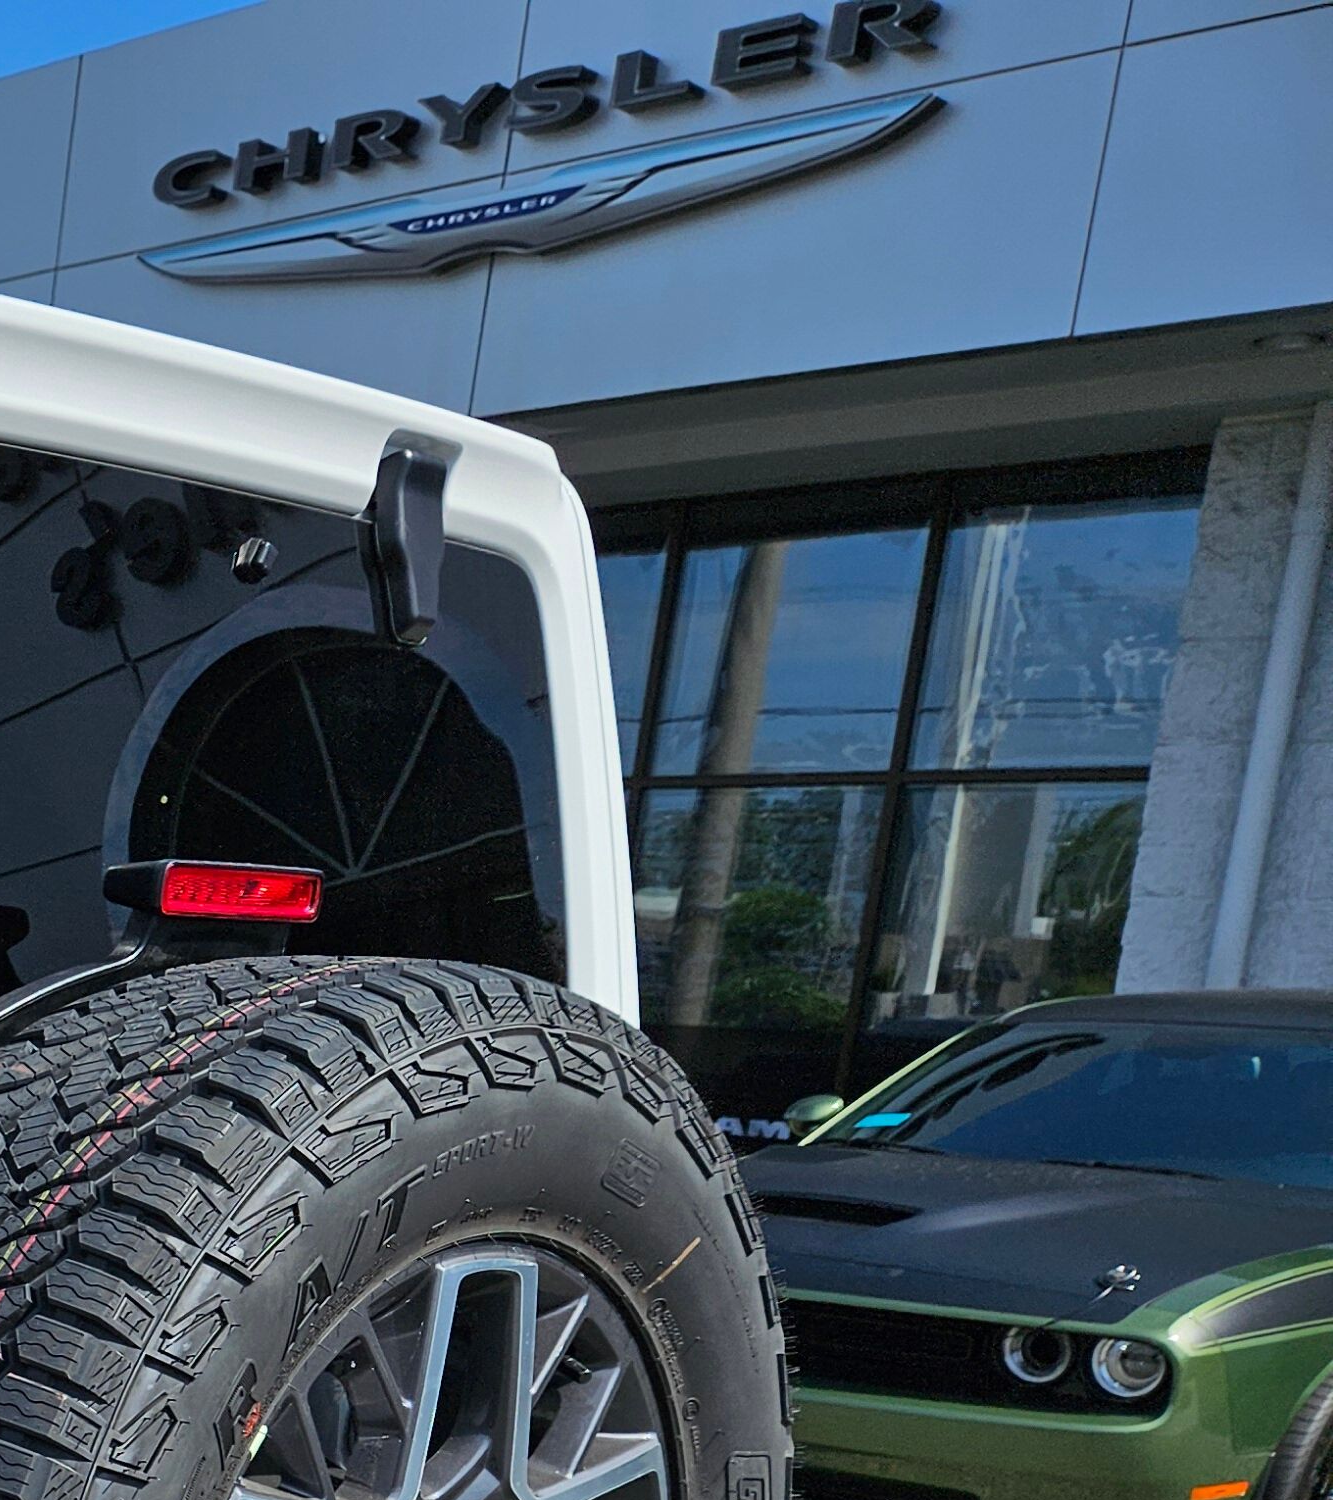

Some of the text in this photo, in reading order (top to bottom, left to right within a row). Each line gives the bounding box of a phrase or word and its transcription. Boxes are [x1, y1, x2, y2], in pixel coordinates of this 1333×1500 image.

[151, 0, 939, 206] CHRYSLER
[407, 194, 557, 232] CHRYSLER
[715, 1115, 791, 1141] AM
